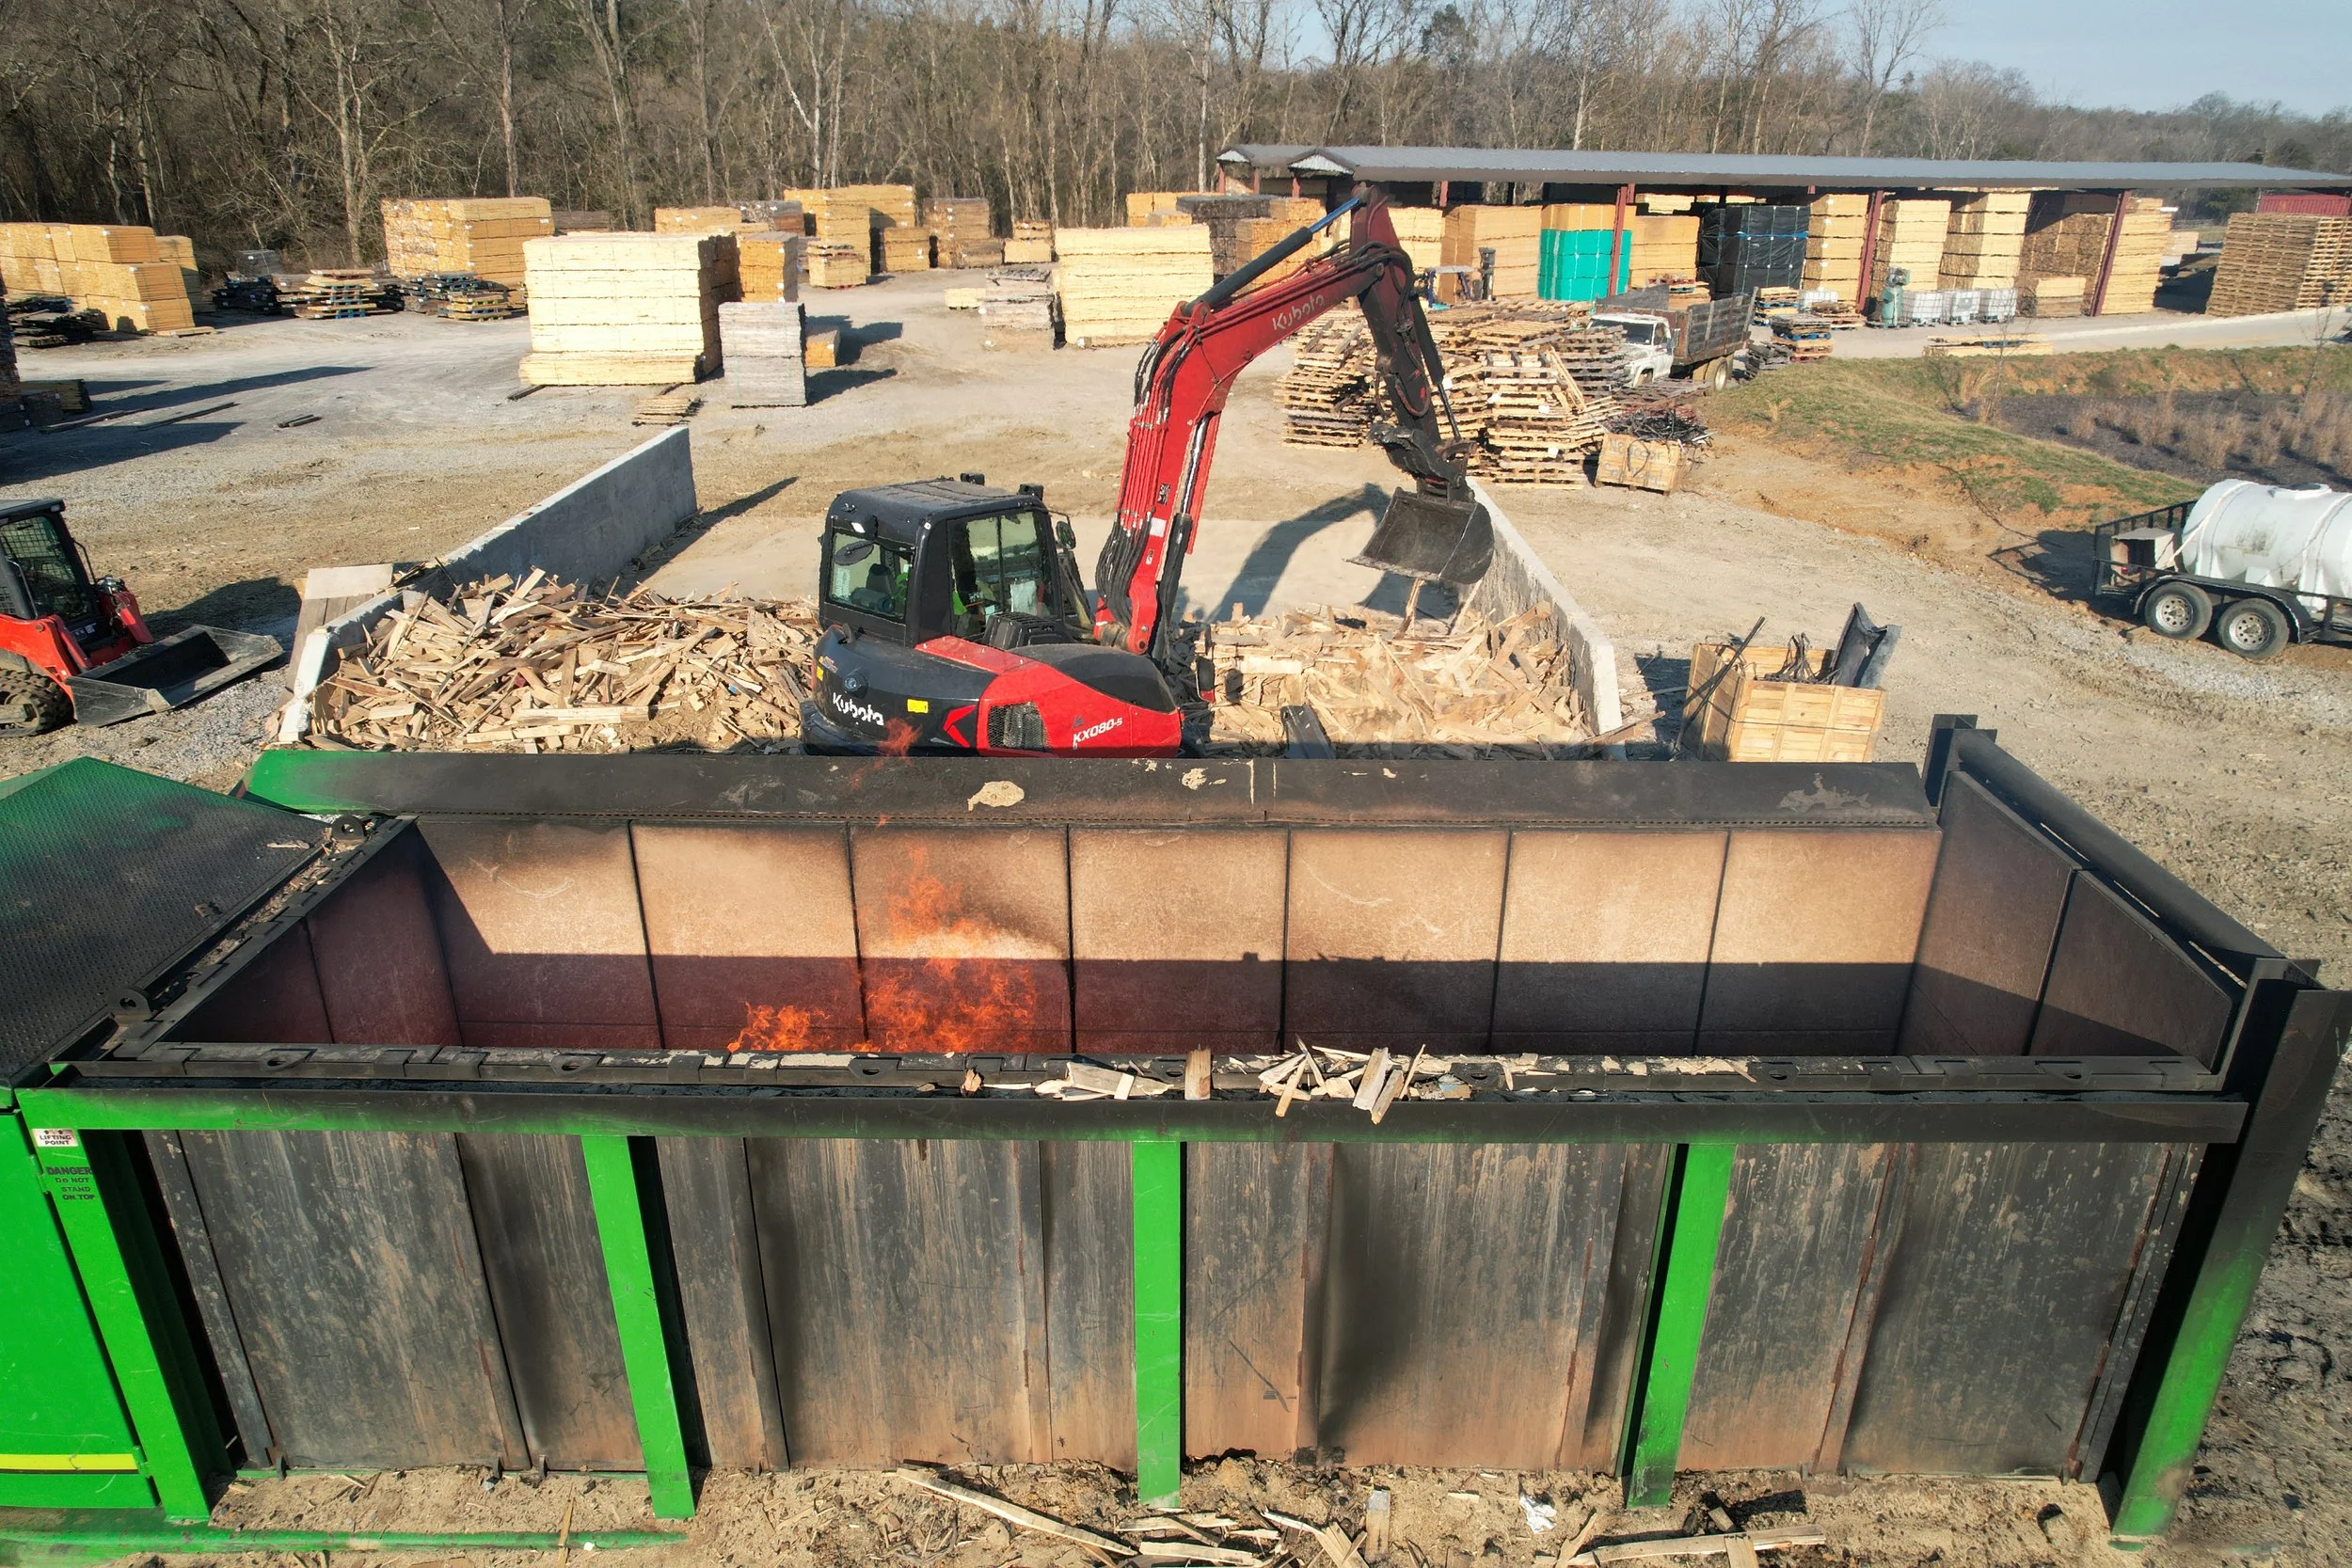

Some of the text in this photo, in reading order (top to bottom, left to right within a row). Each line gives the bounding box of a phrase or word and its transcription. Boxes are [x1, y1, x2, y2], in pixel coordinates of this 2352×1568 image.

[1272, 293, 1326, 331] Kubota
[832, 691, 884, 726] Kubota
[1073, 717, 1123, 743] KX080-5
[46, 1166, 93, 1176] DANGER
